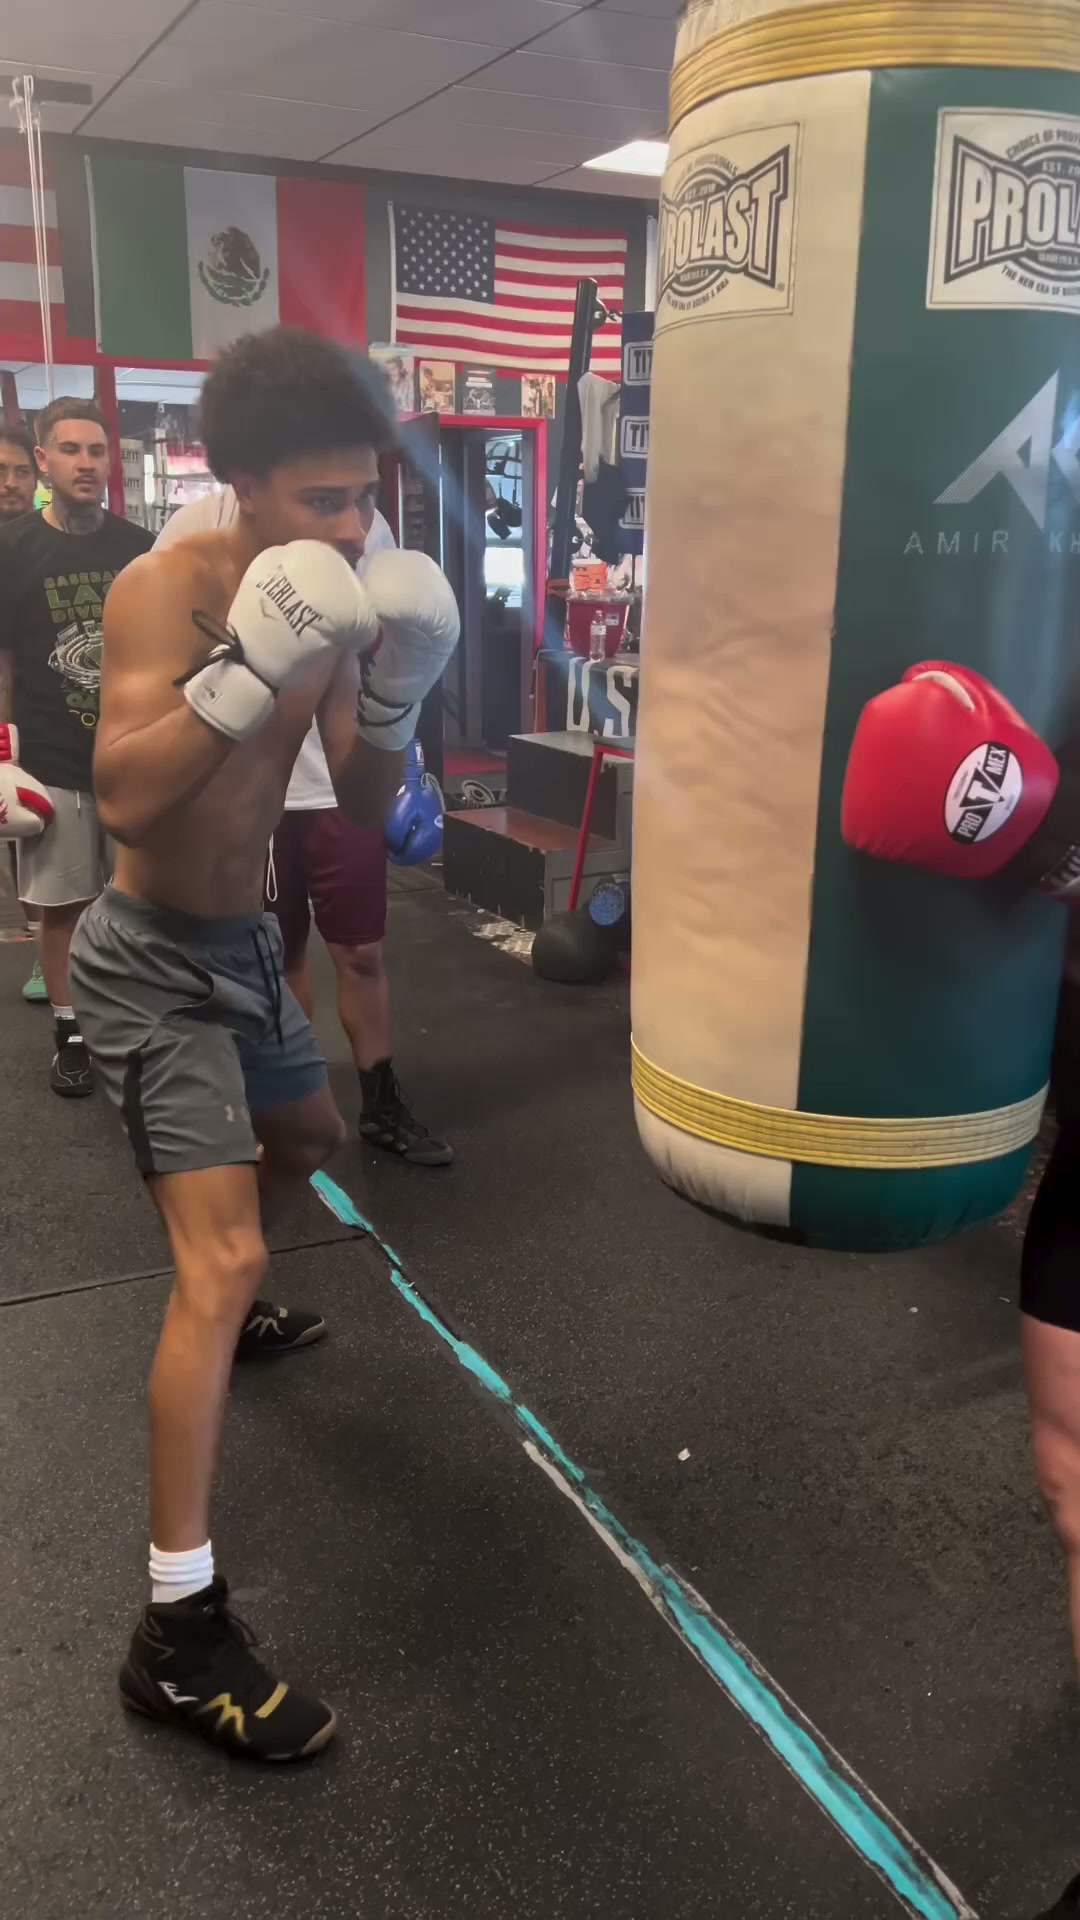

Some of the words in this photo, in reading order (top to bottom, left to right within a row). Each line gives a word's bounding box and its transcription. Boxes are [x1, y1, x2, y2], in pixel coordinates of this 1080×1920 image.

[951, 146, 1080, 270] PROL
[903, 530, 1009, 555] AMIR
[956, 812, 984, 839] PRO
[984, 746, 1007, 775] MEX
